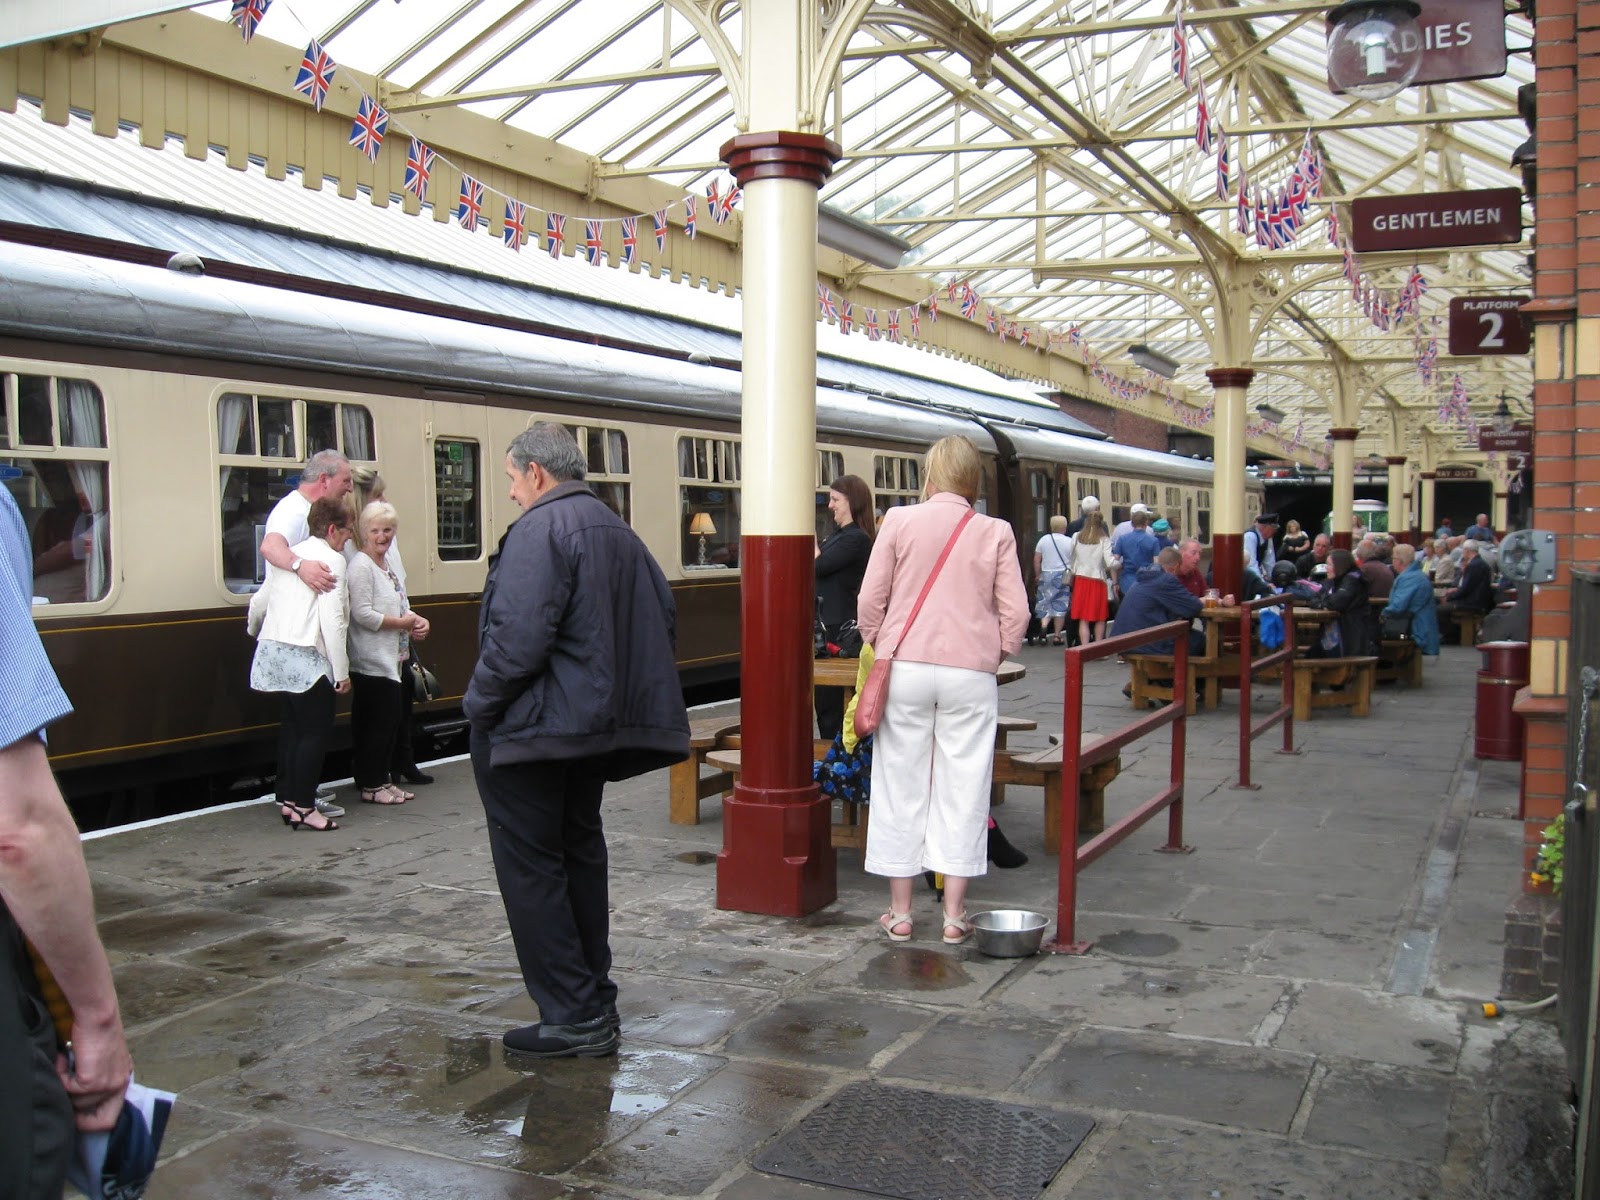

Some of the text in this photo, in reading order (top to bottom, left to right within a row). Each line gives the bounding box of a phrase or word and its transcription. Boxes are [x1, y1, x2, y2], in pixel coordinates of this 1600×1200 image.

[1373, 208, 1500, 231] GENTLEMEN
[1463, 301, 1519, 310] PLATFORM
[1479, 312, 1503, 346] 2
[1516, 456, 1525, 468] 2
